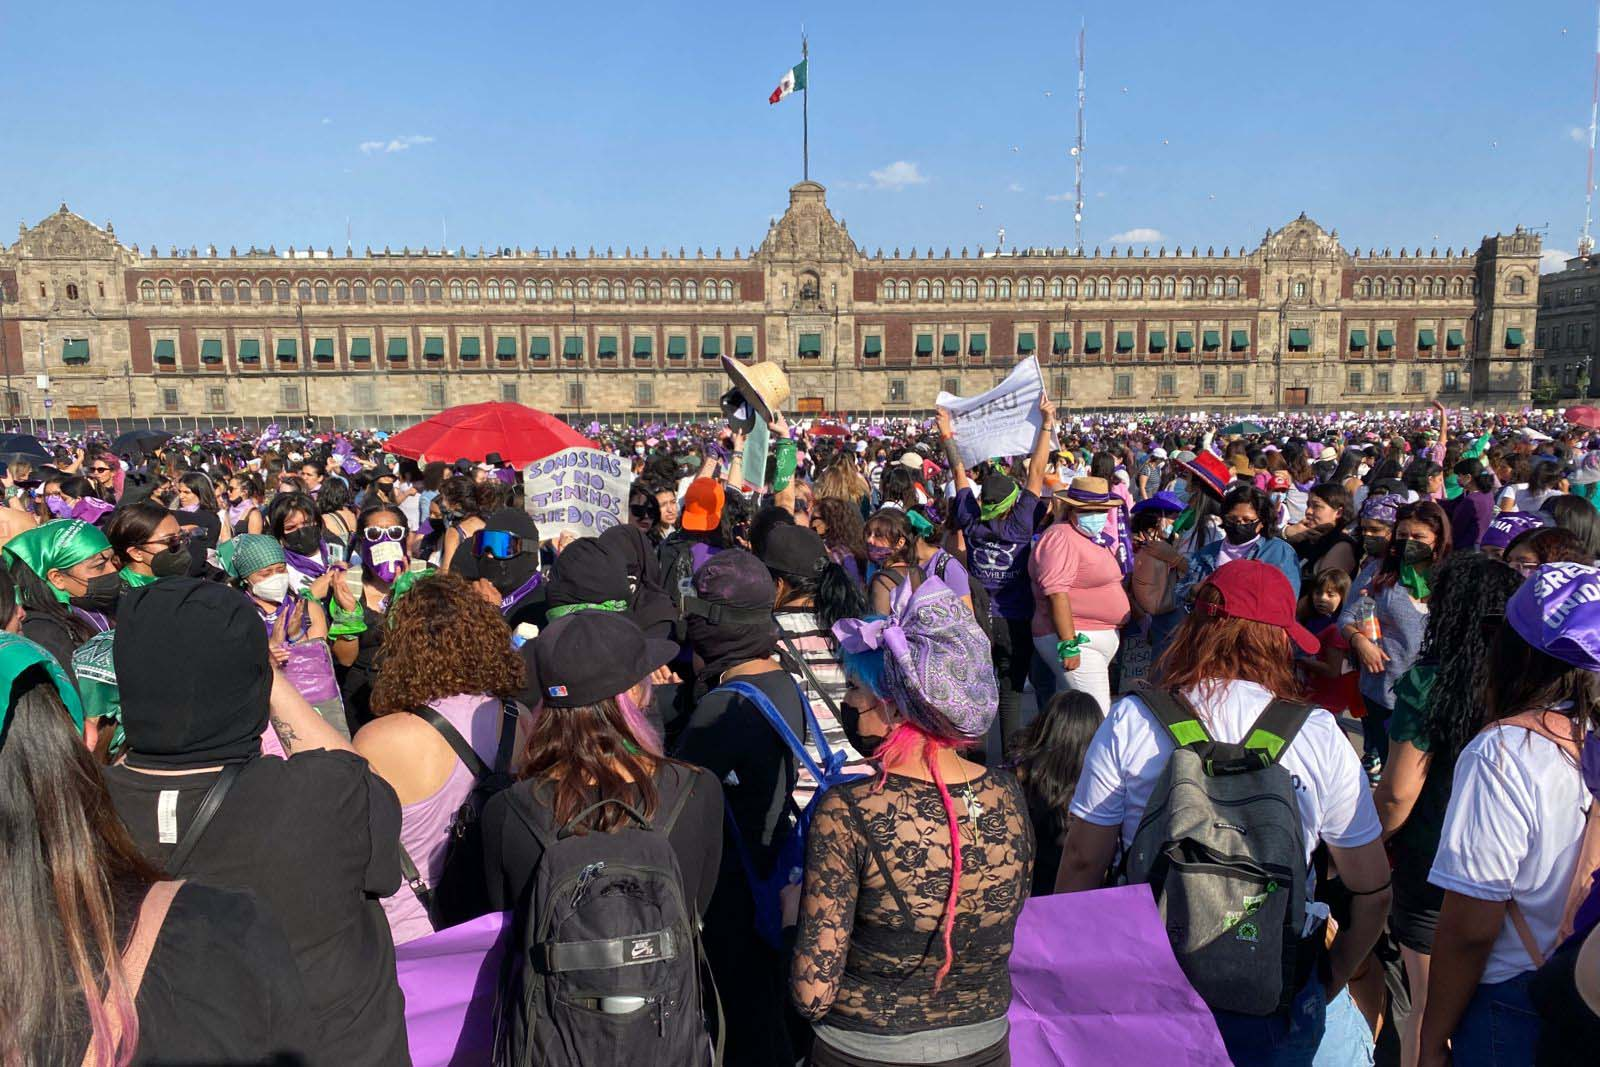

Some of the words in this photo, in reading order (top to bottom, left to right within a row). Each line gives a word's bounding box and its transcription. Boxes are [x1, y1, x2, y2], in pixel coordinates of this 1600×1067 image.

[529, 451, 588, 479] SOMOS
[551, 471, 566, 486] Y
[573, 470, 604, 490] NO
[531, 485, 621, 515] TENEMOS
[531, 505, 594, 527] MIEDO
